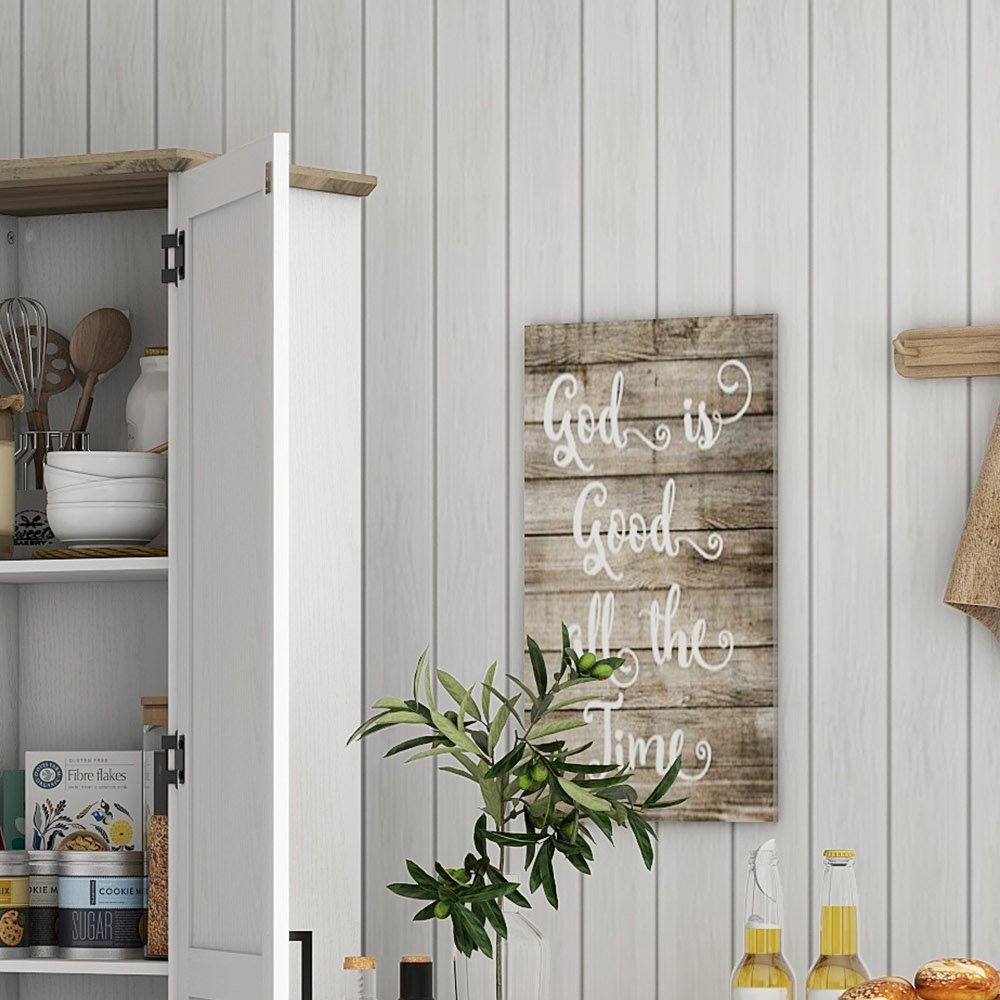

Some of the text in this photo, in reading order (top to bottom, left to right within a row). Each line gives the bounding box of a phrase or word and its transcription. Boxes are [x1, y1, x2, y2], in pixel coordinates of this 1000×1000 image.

[544, 359, 752, 472] God is
[573, 478, 723, 581] Good
[638, 583, 735, 671] the
[67, 767, 127, 782] Fibre flakes
[583, 691, 712, 781] Time
[71, 910, 113, 941] SUGAR
[98, 887, 134, 895] COOKIE
